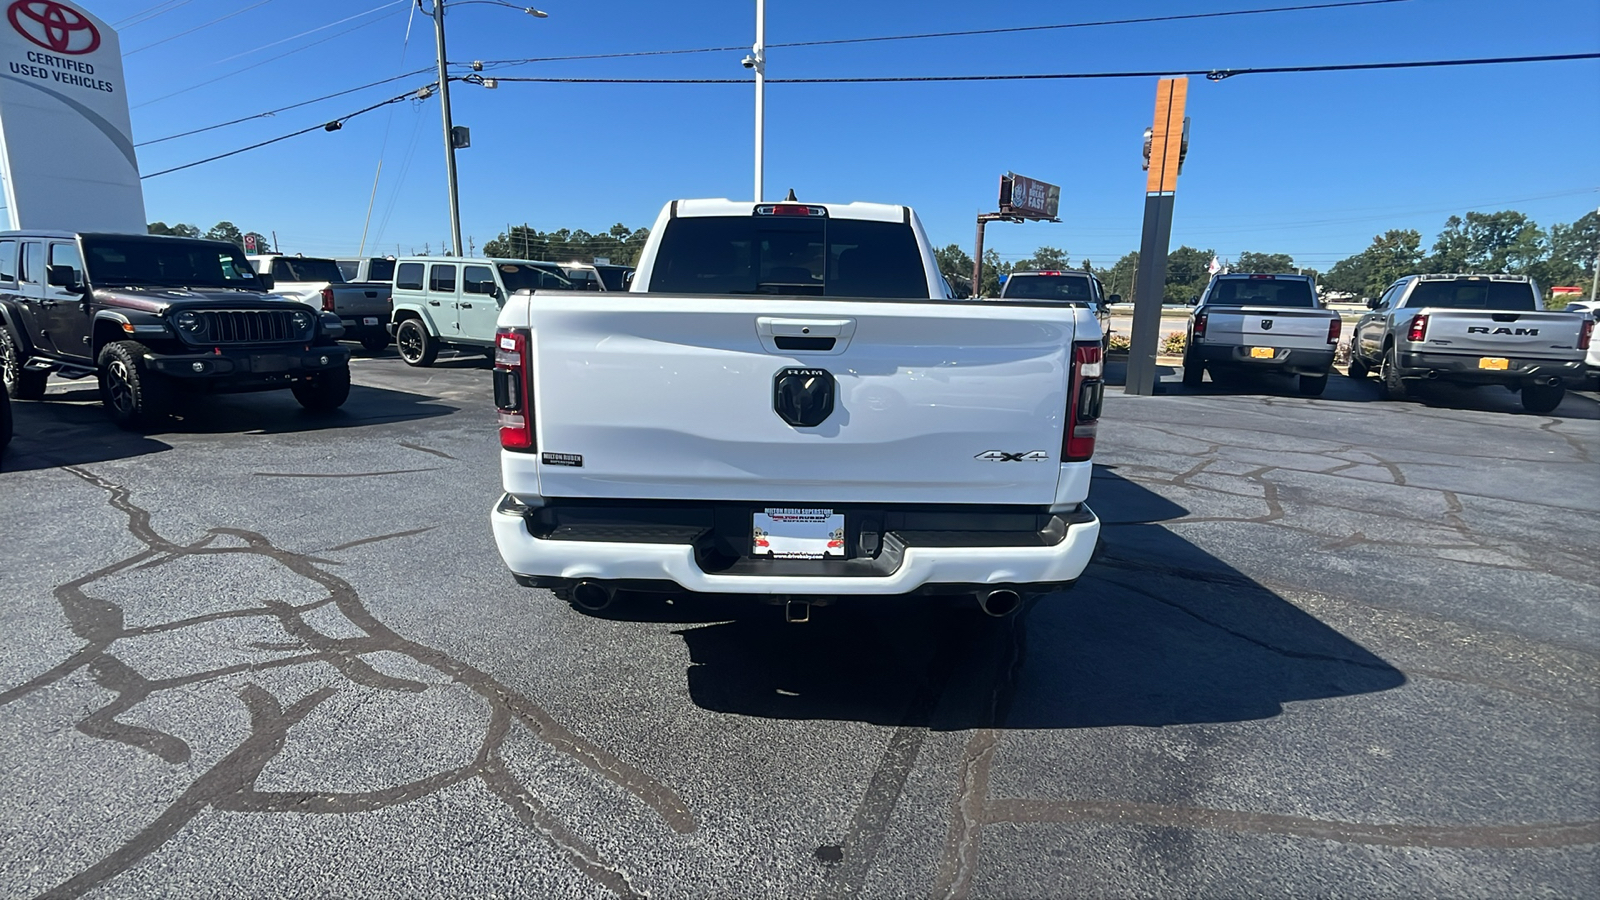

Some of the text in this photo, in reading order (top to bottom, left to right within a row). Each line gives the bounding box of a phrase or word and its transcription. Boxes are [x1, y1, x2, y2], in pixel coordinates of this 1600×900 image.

[27, 51, 94, 75] CERTIFIED
[9, 62, 113, 93] USED VEHICLES
[1027, 197, 1044, 210] FAST
[1467, 326, 1540, 336] RAM
[801, 508, 834, 516] SUPERSTORE
